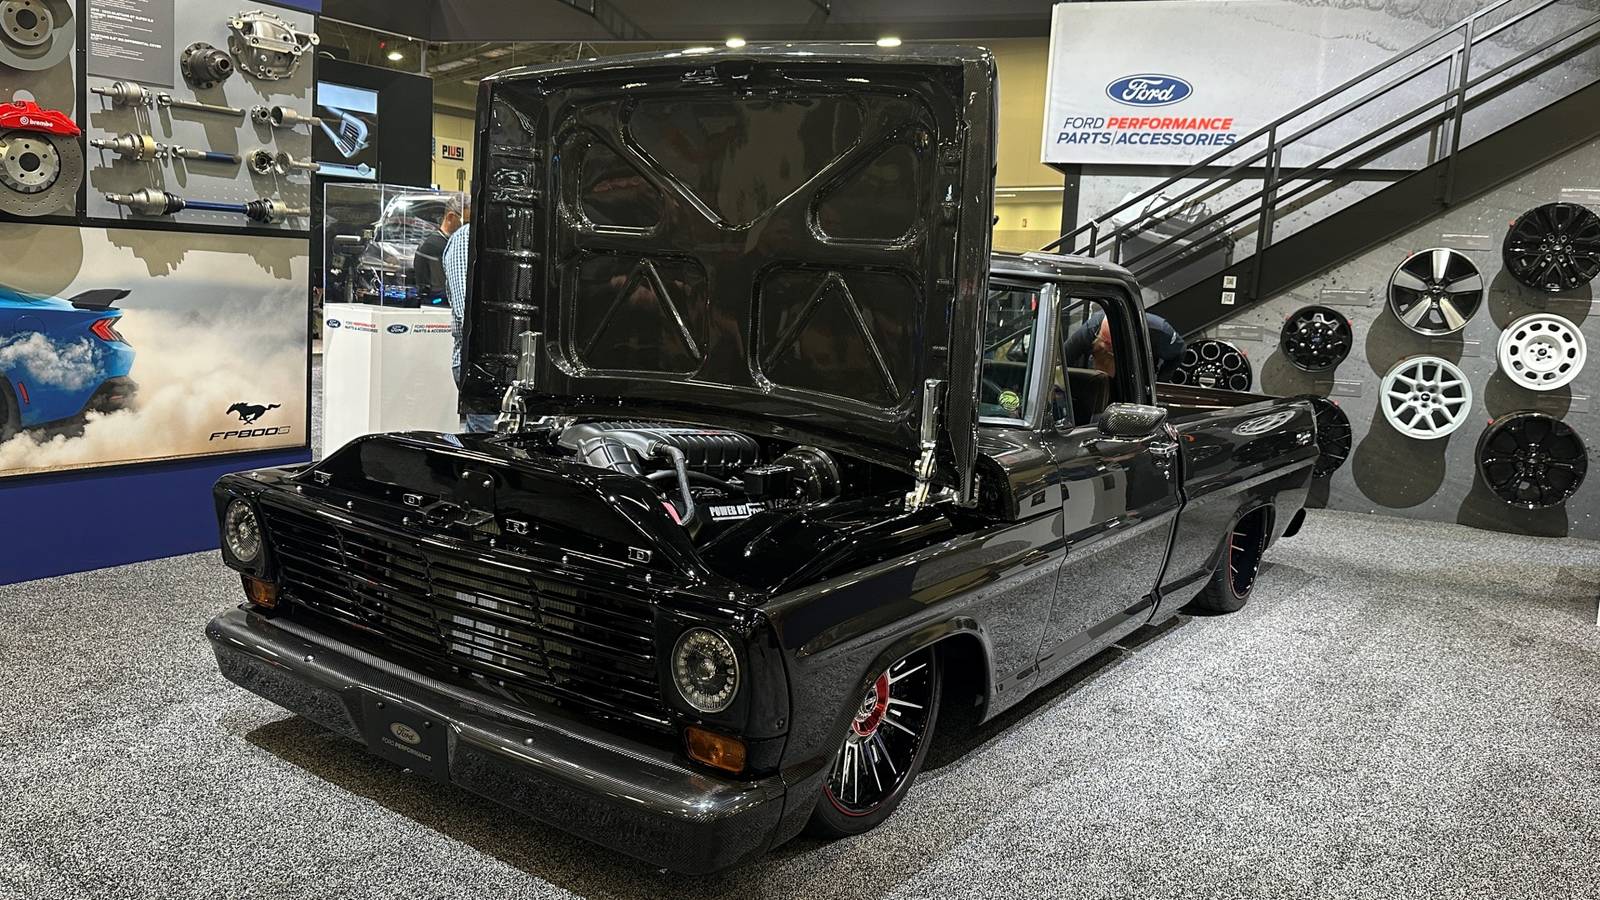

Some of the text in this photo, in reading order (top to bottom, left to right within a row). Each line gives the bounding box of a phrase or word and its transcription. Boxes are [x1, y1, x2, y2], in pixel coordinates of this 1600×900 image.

[1122, 78, 1176, 101] Ford
[29, 119, 54, 127] brembo
[1064, 117, 1234, 130] FORD PERFORMANCE
[442, 145, 464, 158] PIUSI
[209, 426, 291, 441] FP800S
[709, 505, 737, 516] POWER
[736, 504, 747, 515] BY
[382, 736, 395, 746] FORD
